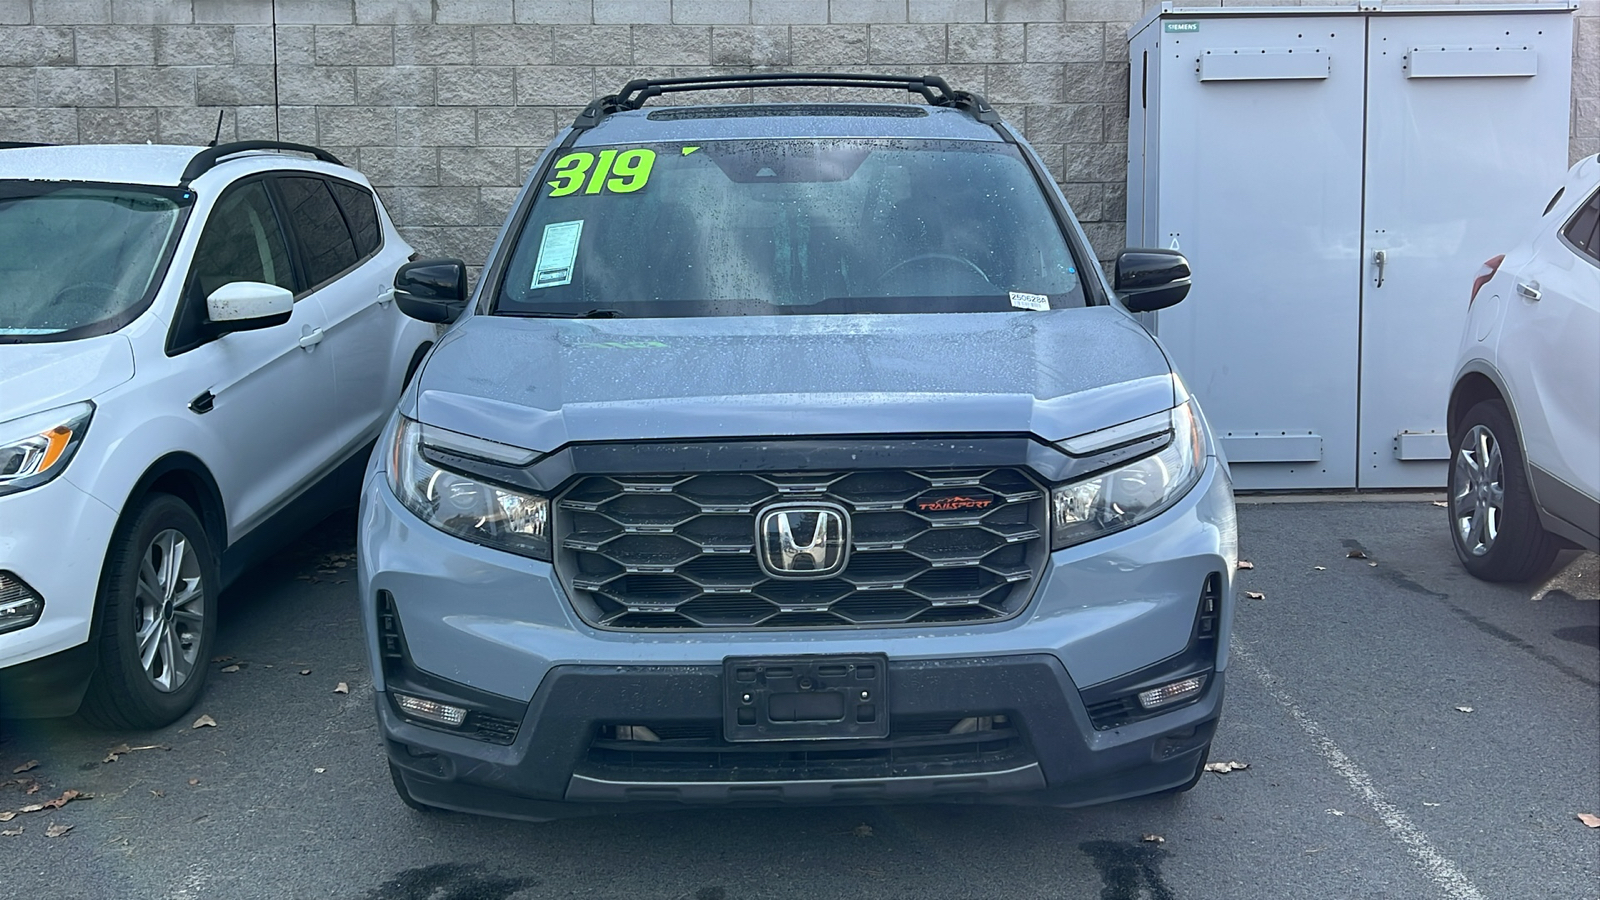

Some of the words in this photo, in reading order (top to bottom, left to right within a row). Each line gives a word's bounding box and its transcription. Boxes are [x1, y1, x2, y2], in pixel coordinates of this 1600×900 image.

[548, 149, 656, 197] 319
[1011, 294, 1046, 304] 250628A
[919, 500, 991, 510] TRAILSPORT
